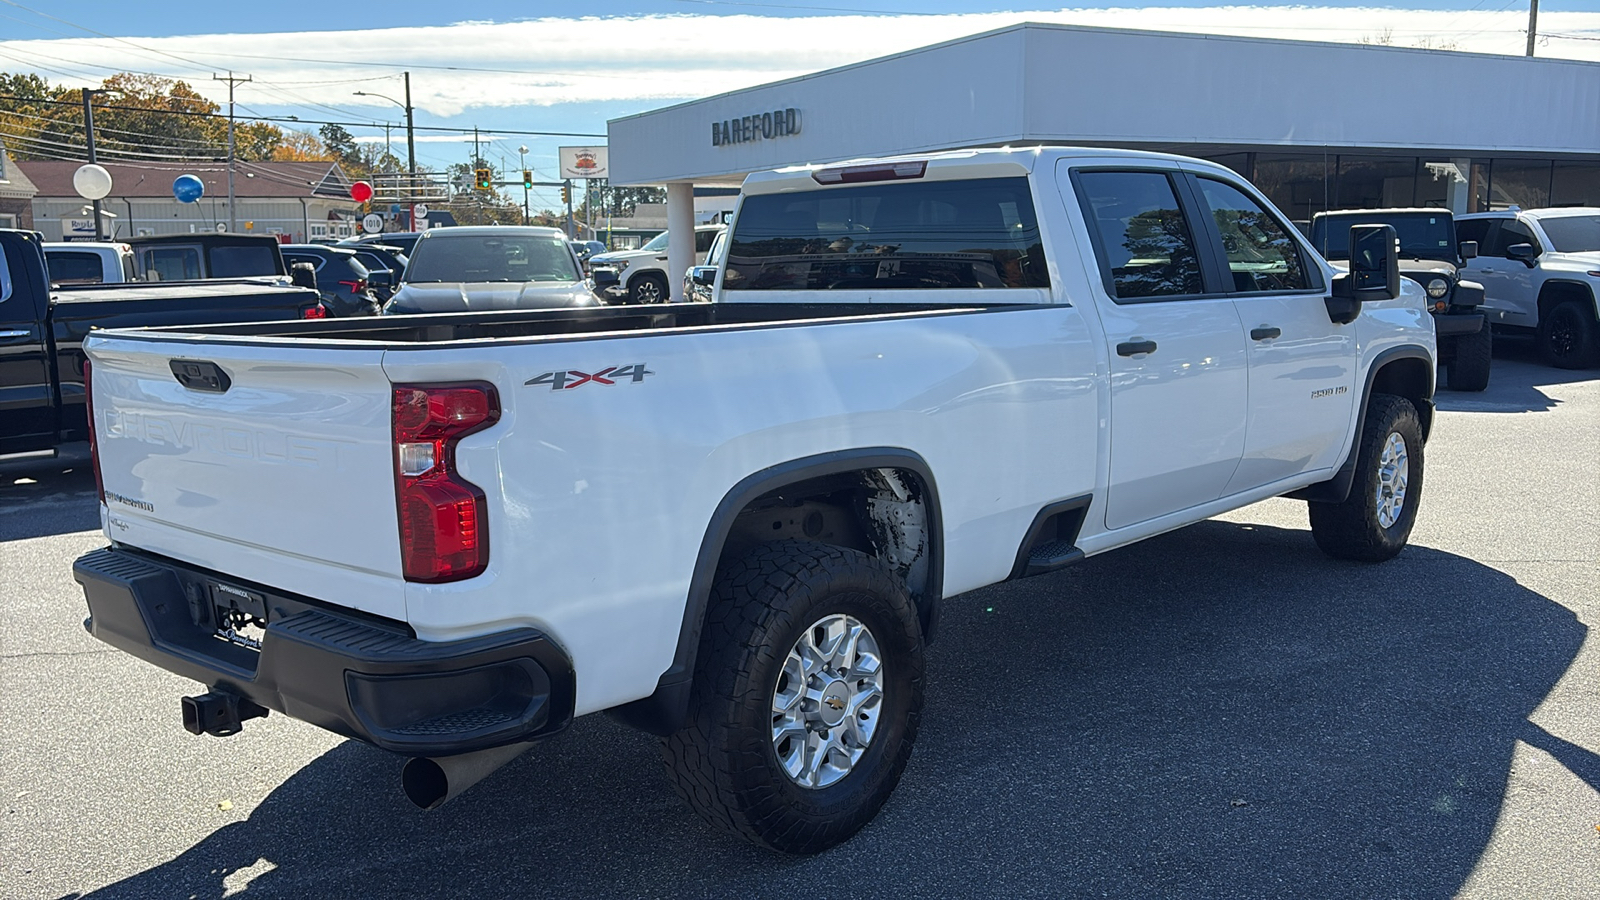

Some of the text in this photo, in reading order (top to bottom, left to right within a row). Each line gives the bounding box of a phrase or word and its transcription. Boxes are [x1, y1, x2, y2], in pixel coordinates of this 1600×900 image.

[712, 108, 802, 146] BAREFORD
[365, 219, 381, 228] 1010
[104, 409, 358, 469] CHEVROLET
